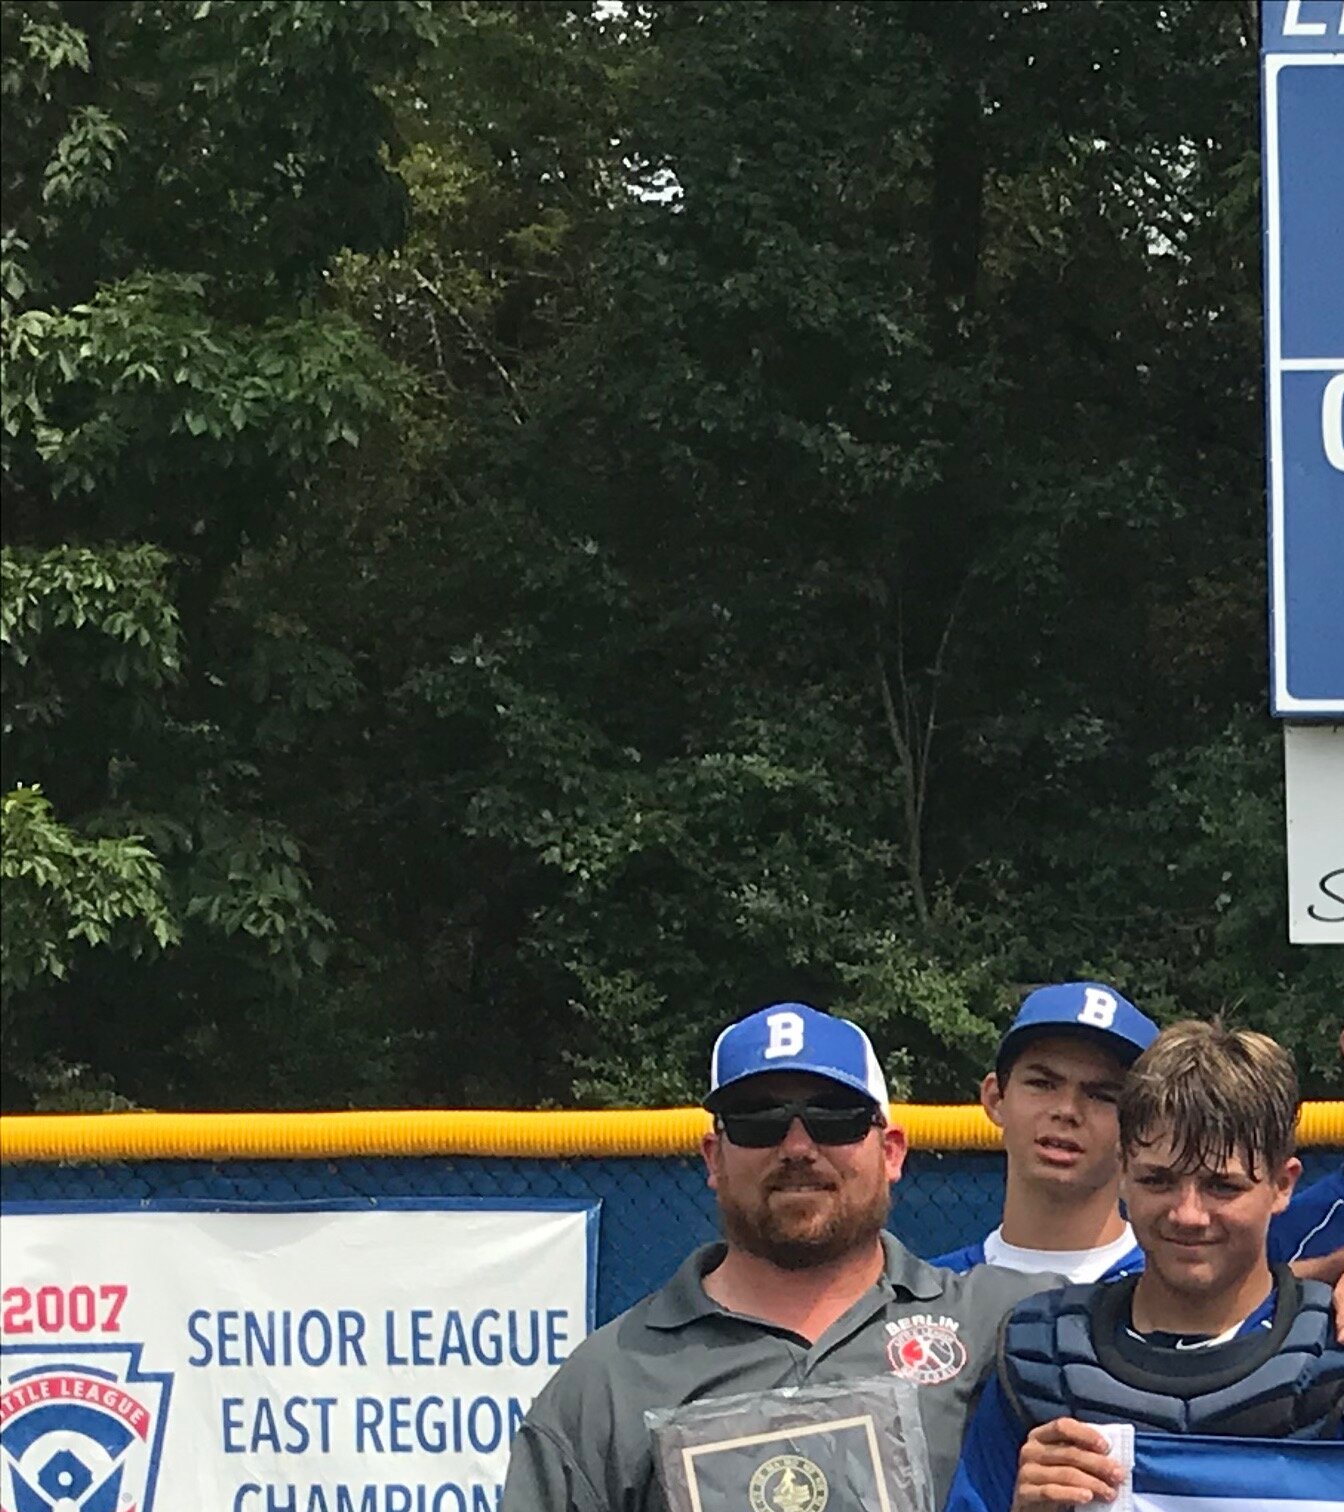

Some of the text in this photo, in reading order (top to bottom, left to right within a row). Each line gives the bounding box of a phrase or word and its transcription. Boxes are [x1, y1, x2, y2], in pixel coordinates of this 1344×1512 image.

[1076, 986, 1118, 1029] B
[764, 1010, 806, 1060] B
[2, 1284, 128, 1335] 2007
[885, 1314, 960, 1337] BERLIN
[188, 1309, 568, 1367] SENIOR LEAGUE
[1, 1379, 145, 1425] TTLE LEAGUE
[222, 1396, 336, 1454] EAST
